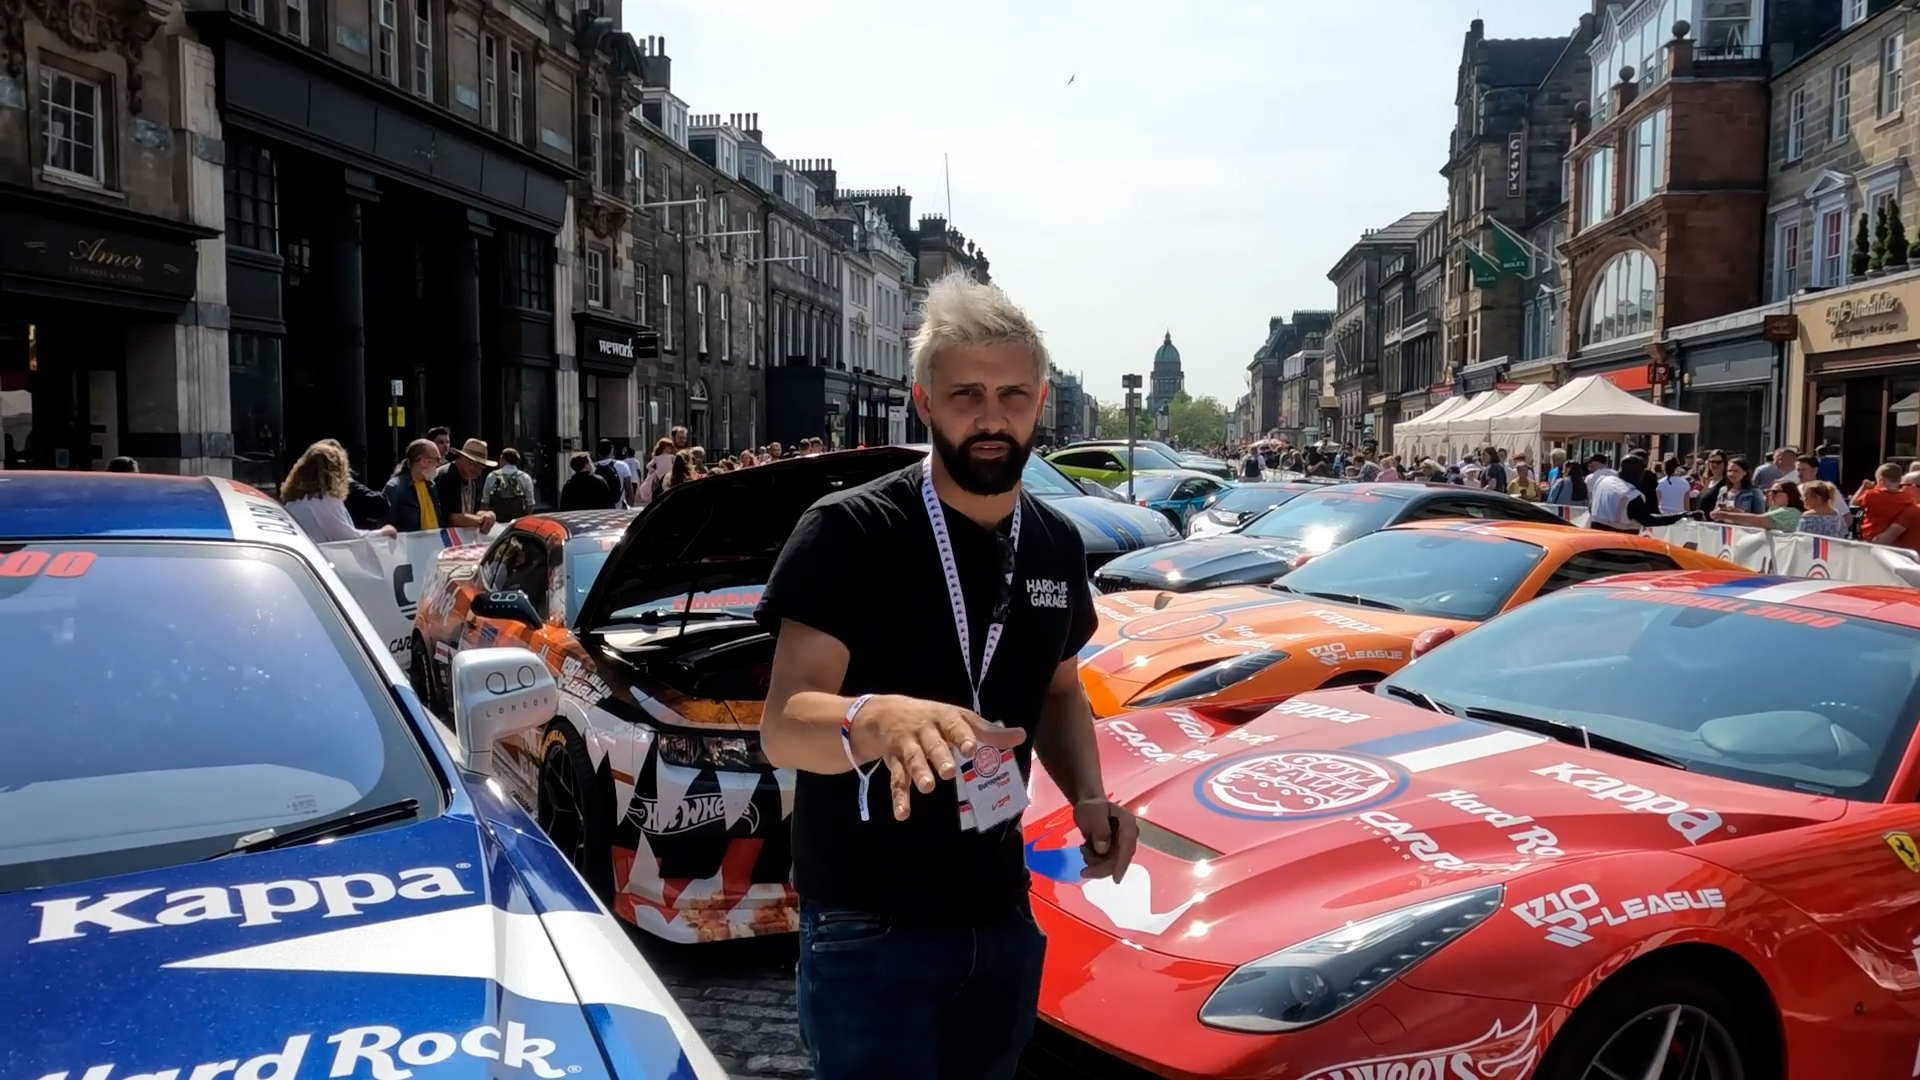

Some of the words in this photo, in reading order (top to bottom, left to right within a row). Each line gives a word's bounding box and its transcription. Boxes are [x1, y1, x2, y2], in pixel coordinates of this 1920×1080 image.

[1509, 139, 1521, 190] Grays
[69, 238, 145, 270] Amor
[598, 337, 634, 359] wework
[1026, 579, 1069, 594] HARD-UP
[1031, 592, 1068, 608] GARAGE
[1742, 605, 1848, 628] 3000
[486, 697, 548, 718] LONDON
[1274, 698, 1372, 724] appa
[1427, 789, 1535, 829] Hard
[1528, 762, 1724, 847] Kappa
[1344, 816, 1412, 862] EYEWEAR
[28, 866, 475, 944] Kappa
[327, 1021, 567, 1080] Rock
